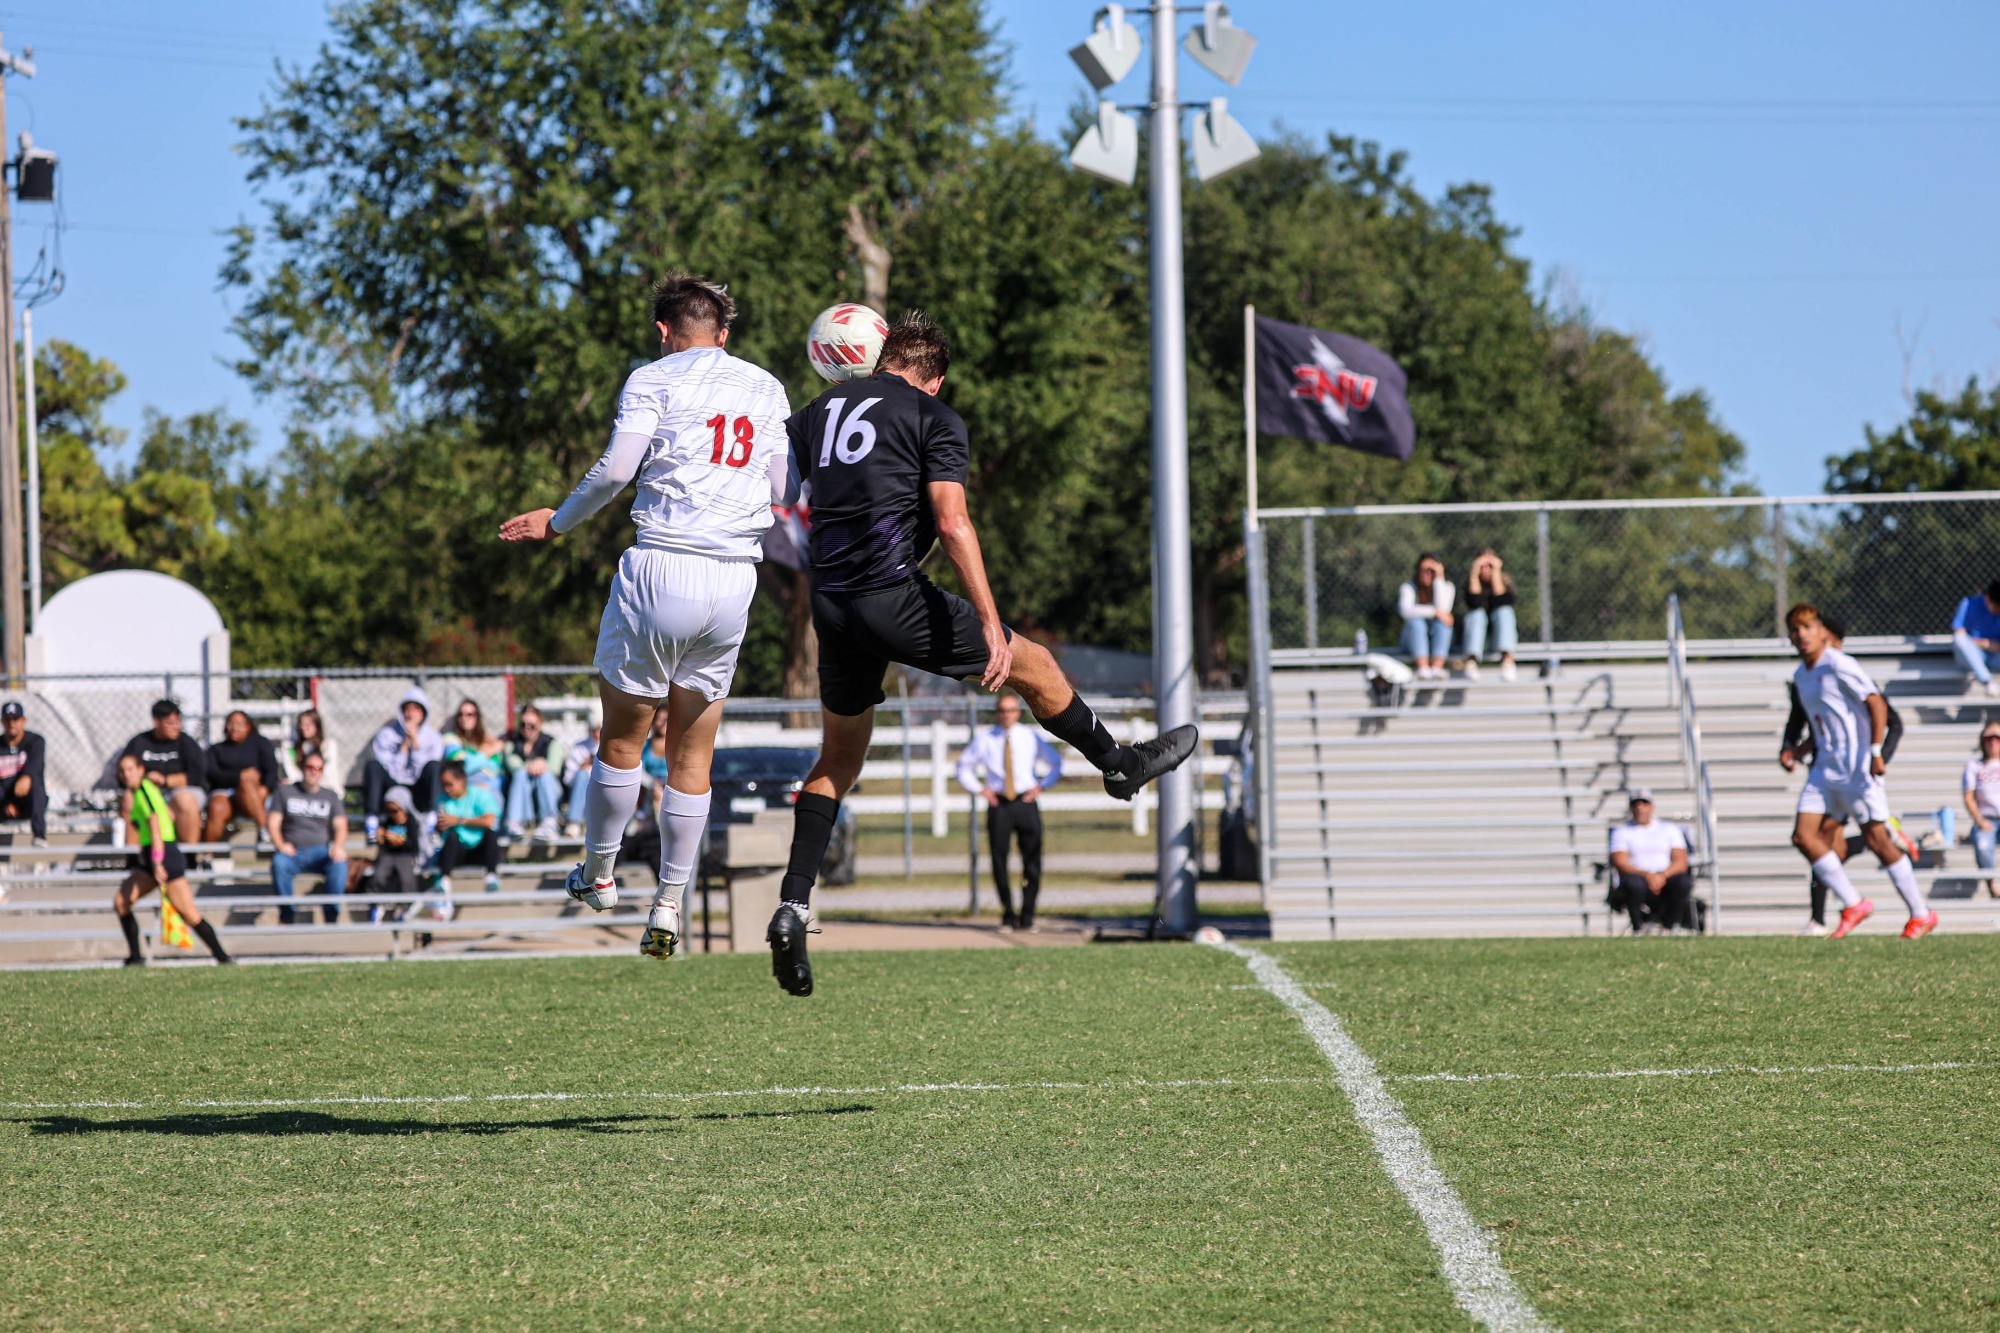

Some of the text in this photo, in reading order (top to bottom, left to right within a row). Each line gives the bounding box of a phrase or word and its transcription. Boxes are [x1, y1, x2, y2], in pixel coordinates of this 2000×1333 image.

[1291, 363, 1378, 412] SNU
[706, 413, 754, 467] 18
[819, 397, 884, 467] 16
